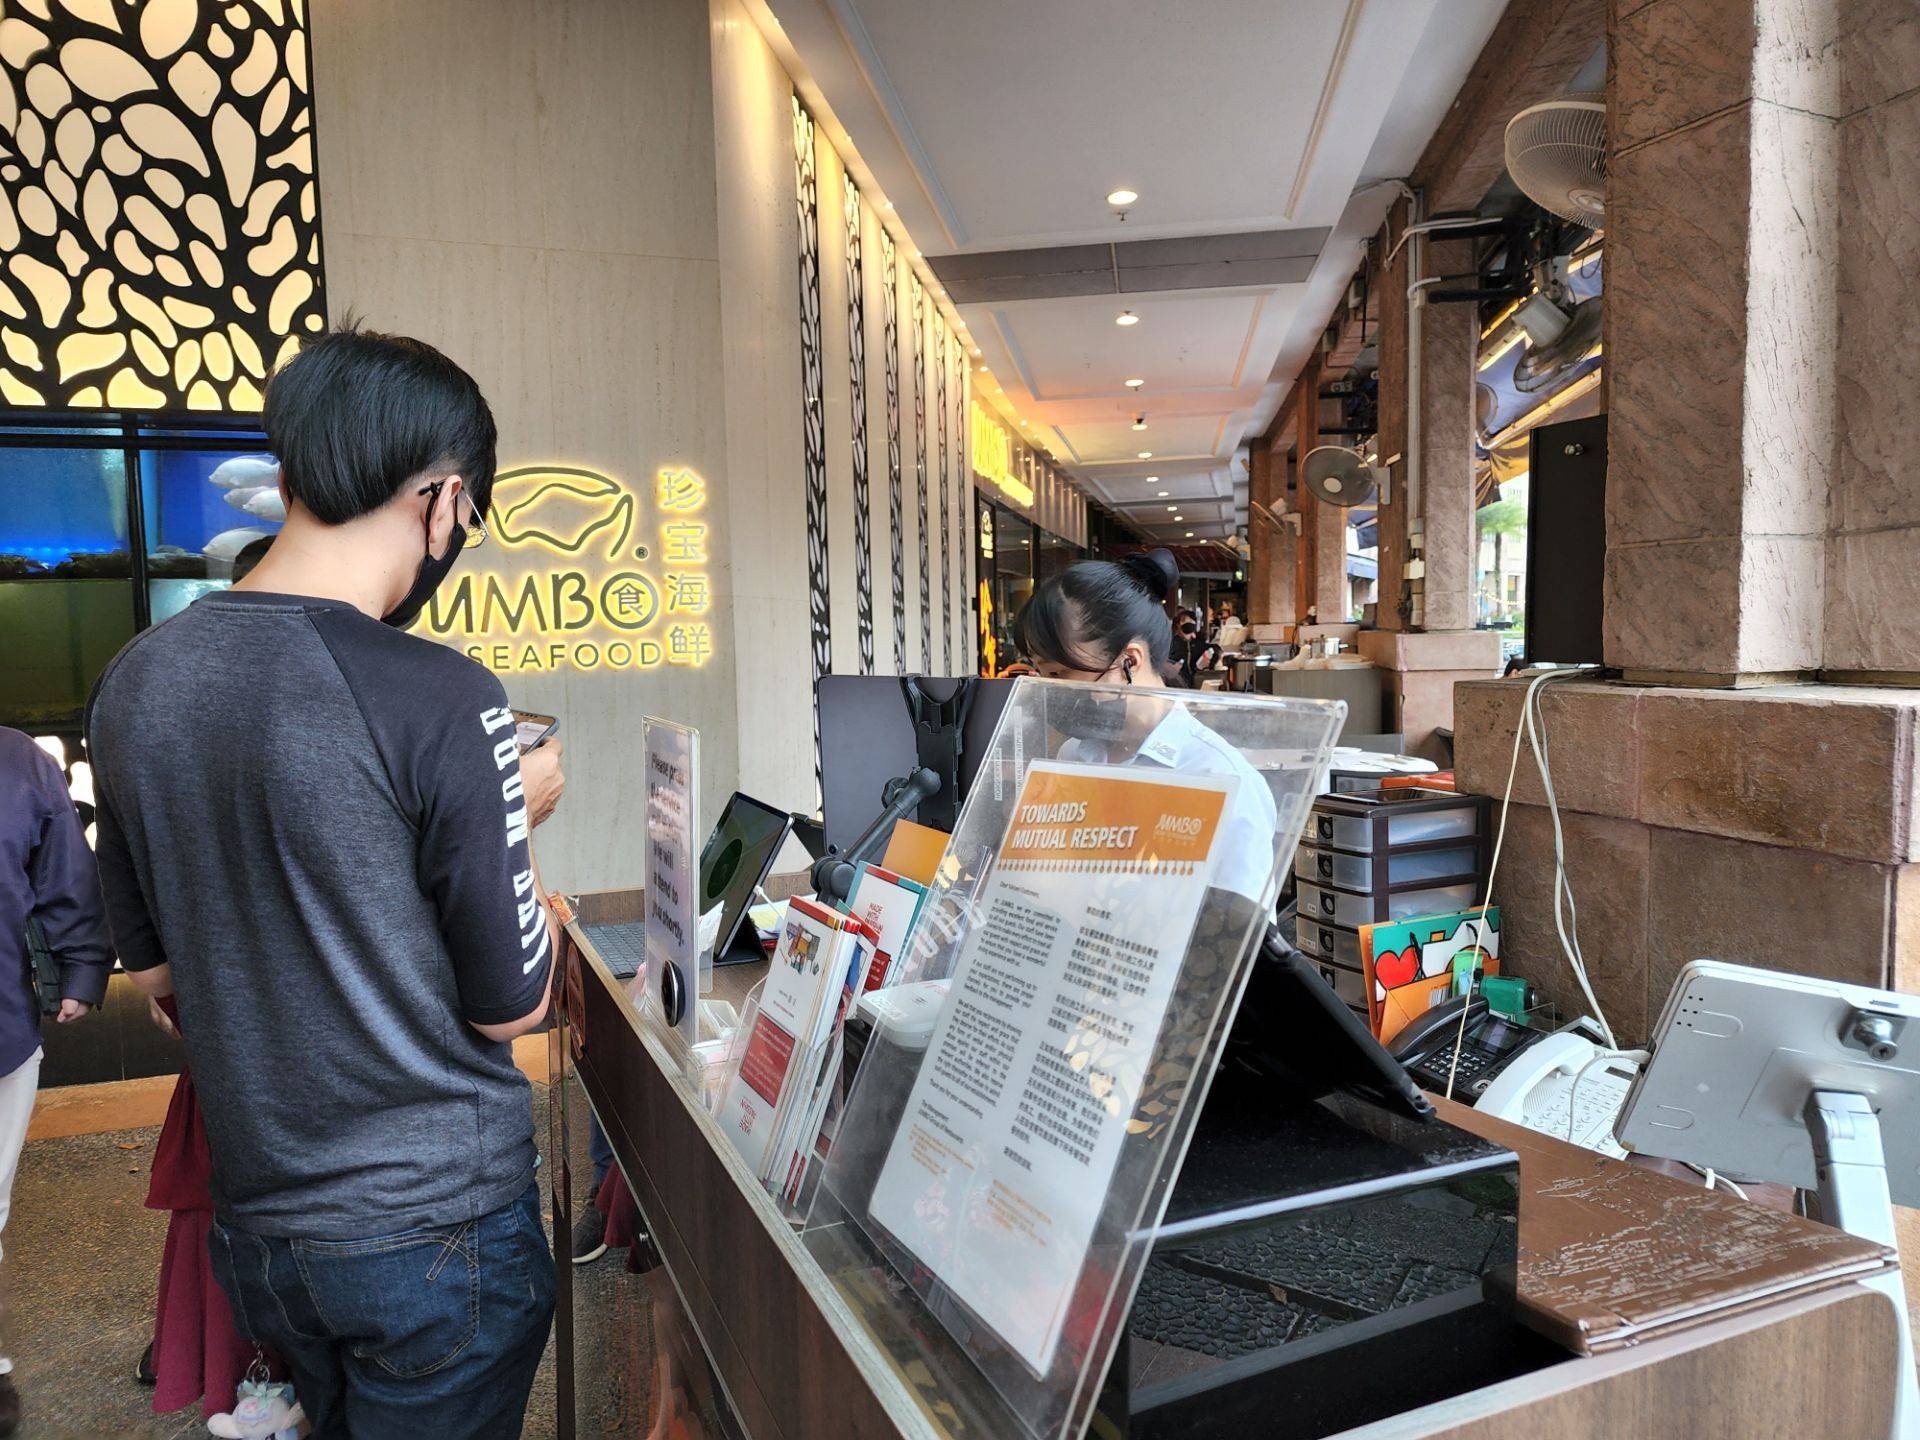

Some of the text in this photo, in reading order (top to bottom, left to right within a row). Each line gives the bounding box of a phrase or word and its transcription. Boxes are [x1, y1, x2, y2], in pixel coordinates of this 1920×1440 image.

[663, 469, 711, 665] 珍宝海鲜
[402, 572, 659, 634] UMBO
[468, 643, 661, 669] SEAFOOD
[1020, 801, 1089, 824] TOWARDS
[1011, 828, 1068, 850] MUTUAL
[1070, 825, 1139, 850] RESPECT
[663, 850, 674, 870] will
[672, 885, 679, 906] to
